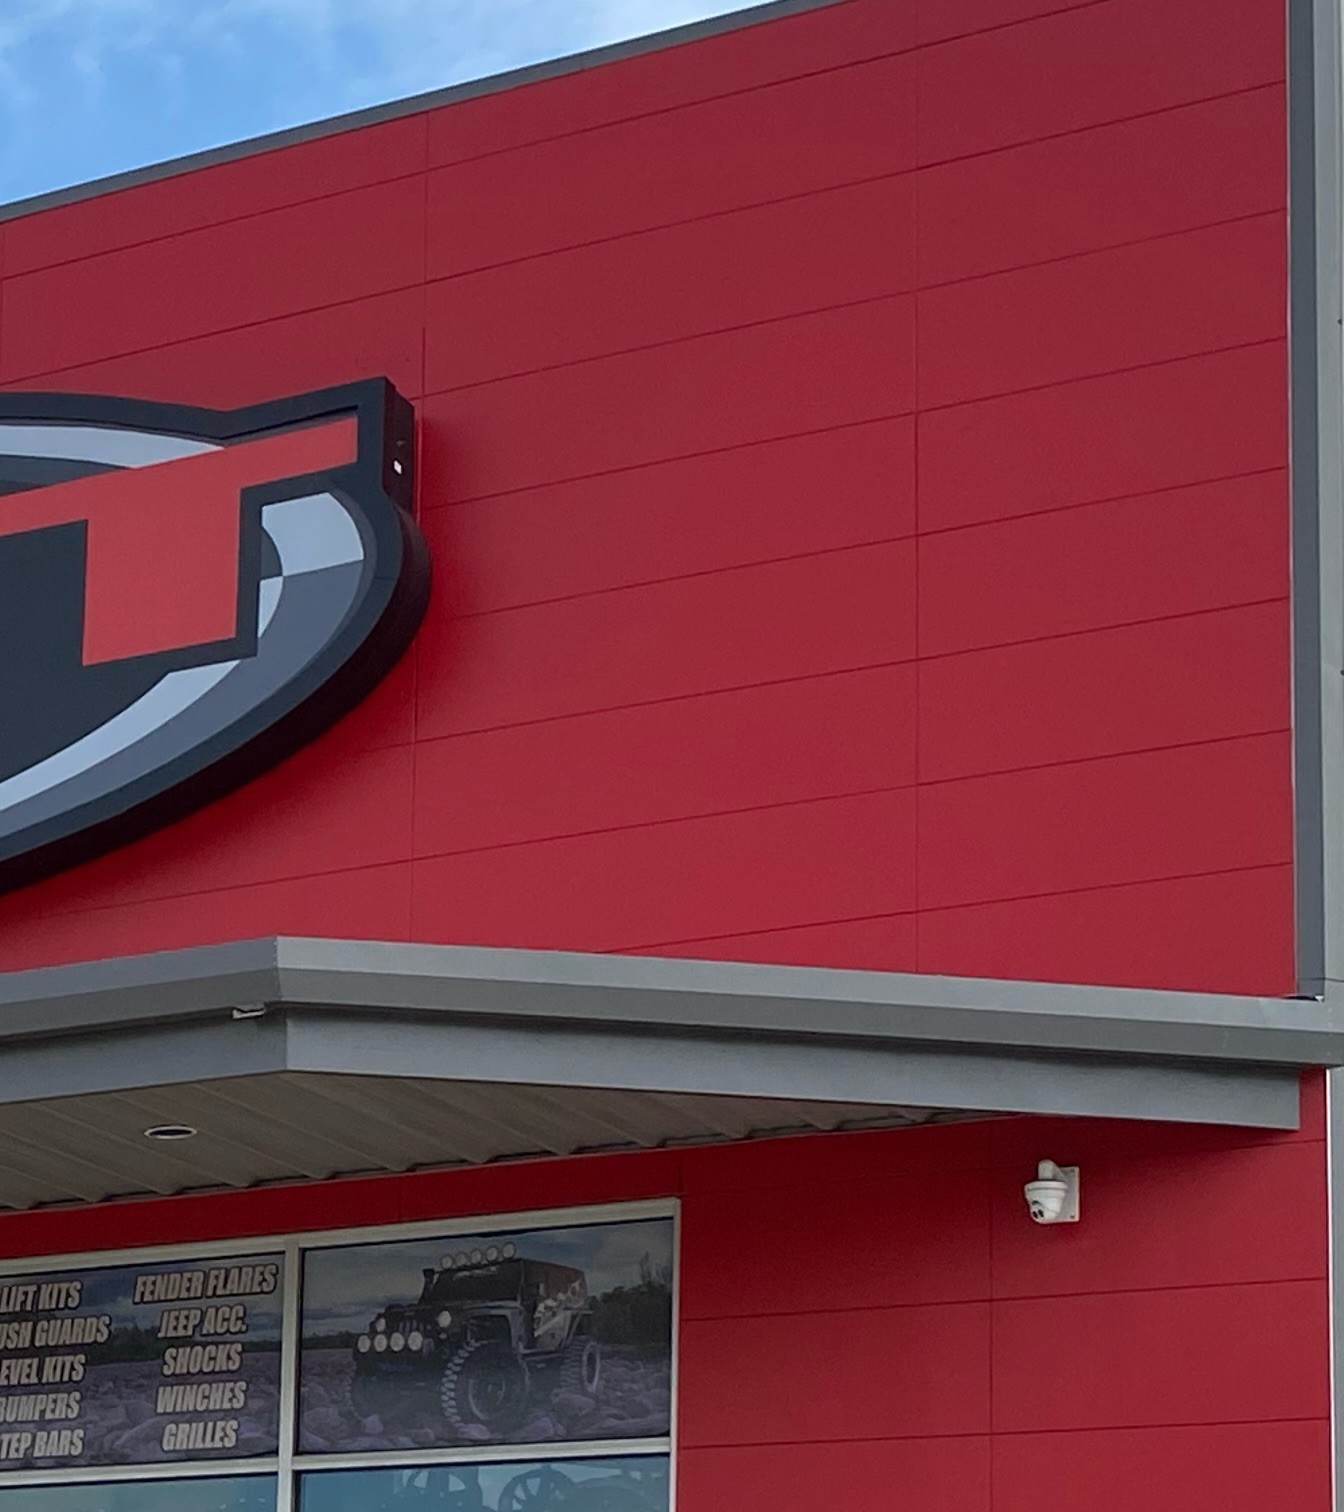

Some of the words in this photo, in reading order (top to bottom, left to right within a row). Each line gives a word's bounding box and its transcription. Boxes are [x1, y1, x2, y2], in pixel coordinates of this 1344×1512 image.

[0, 1284, 38, 1314] LIFT
[39, 1280, 83, 1311] KITS
[133, 1270, 205, 1304] FENDER
[206, 1264, 278, 1298] FLARES
[34, 1316, 111, 1348] GUARDS
[158, 1308, 202, 1338] JEEP
[202, 1304, 248, 1335] ACC.
[41, 1354, 86, 1383] KITS
[162, 1343, 243, 1377] SHOCKS
[156, 1381, 248, 1414] WINCHES
[33, 1429, 85, 1458] BARS
[162, 1420, 240, 1452] GRILLES
